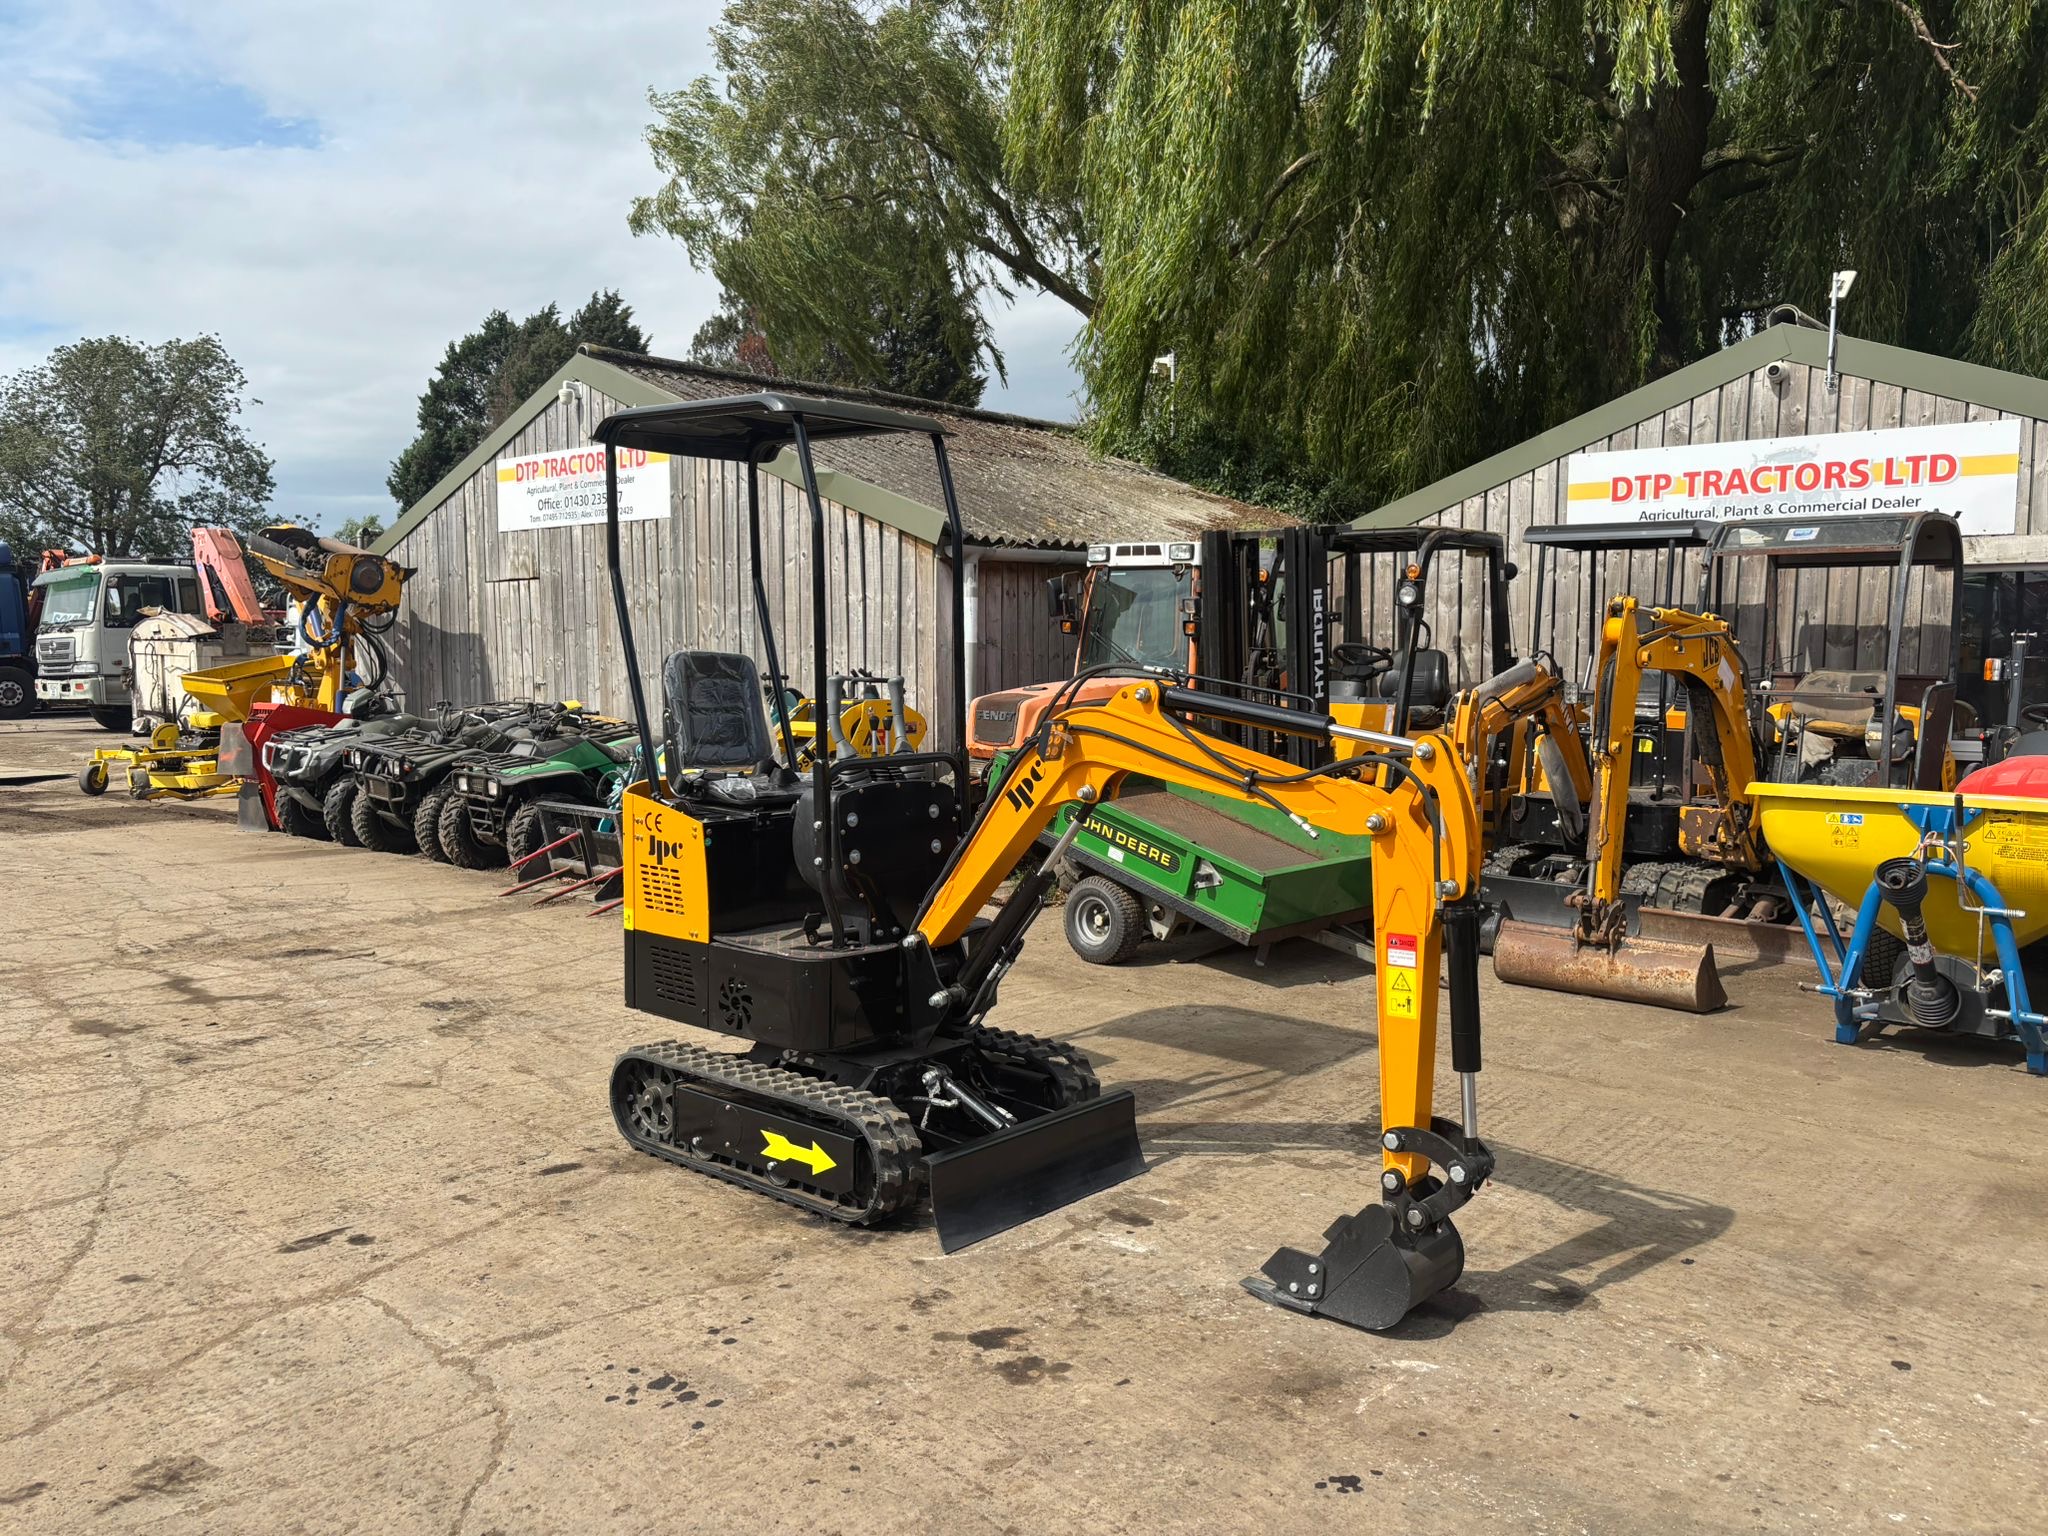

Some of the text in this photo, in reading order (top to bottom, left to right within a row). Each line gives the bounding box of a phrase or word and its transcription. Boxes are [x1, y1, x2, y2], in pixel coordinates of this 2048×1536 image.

[516, 448, 647, 482] DTP TRACTOR LTD
[1611, 453, 1958, 502] DTP TRACTORS LTD
[559, 481, 573, 491] Plant
[616, 474, 635, 485] Dealer
[538, 490, 623, 511] Office: 01430 2357
[1638, 495, 1922, 522] Agricultural, Plant & Commercial Dealer
[1313, 588, 1325, 699] HYUNDAI
[1702, 636, 1720, 668] JCB
[976, 709, 1017, 722] FENDT
[1115, 831, 1171, 867] DEERE
